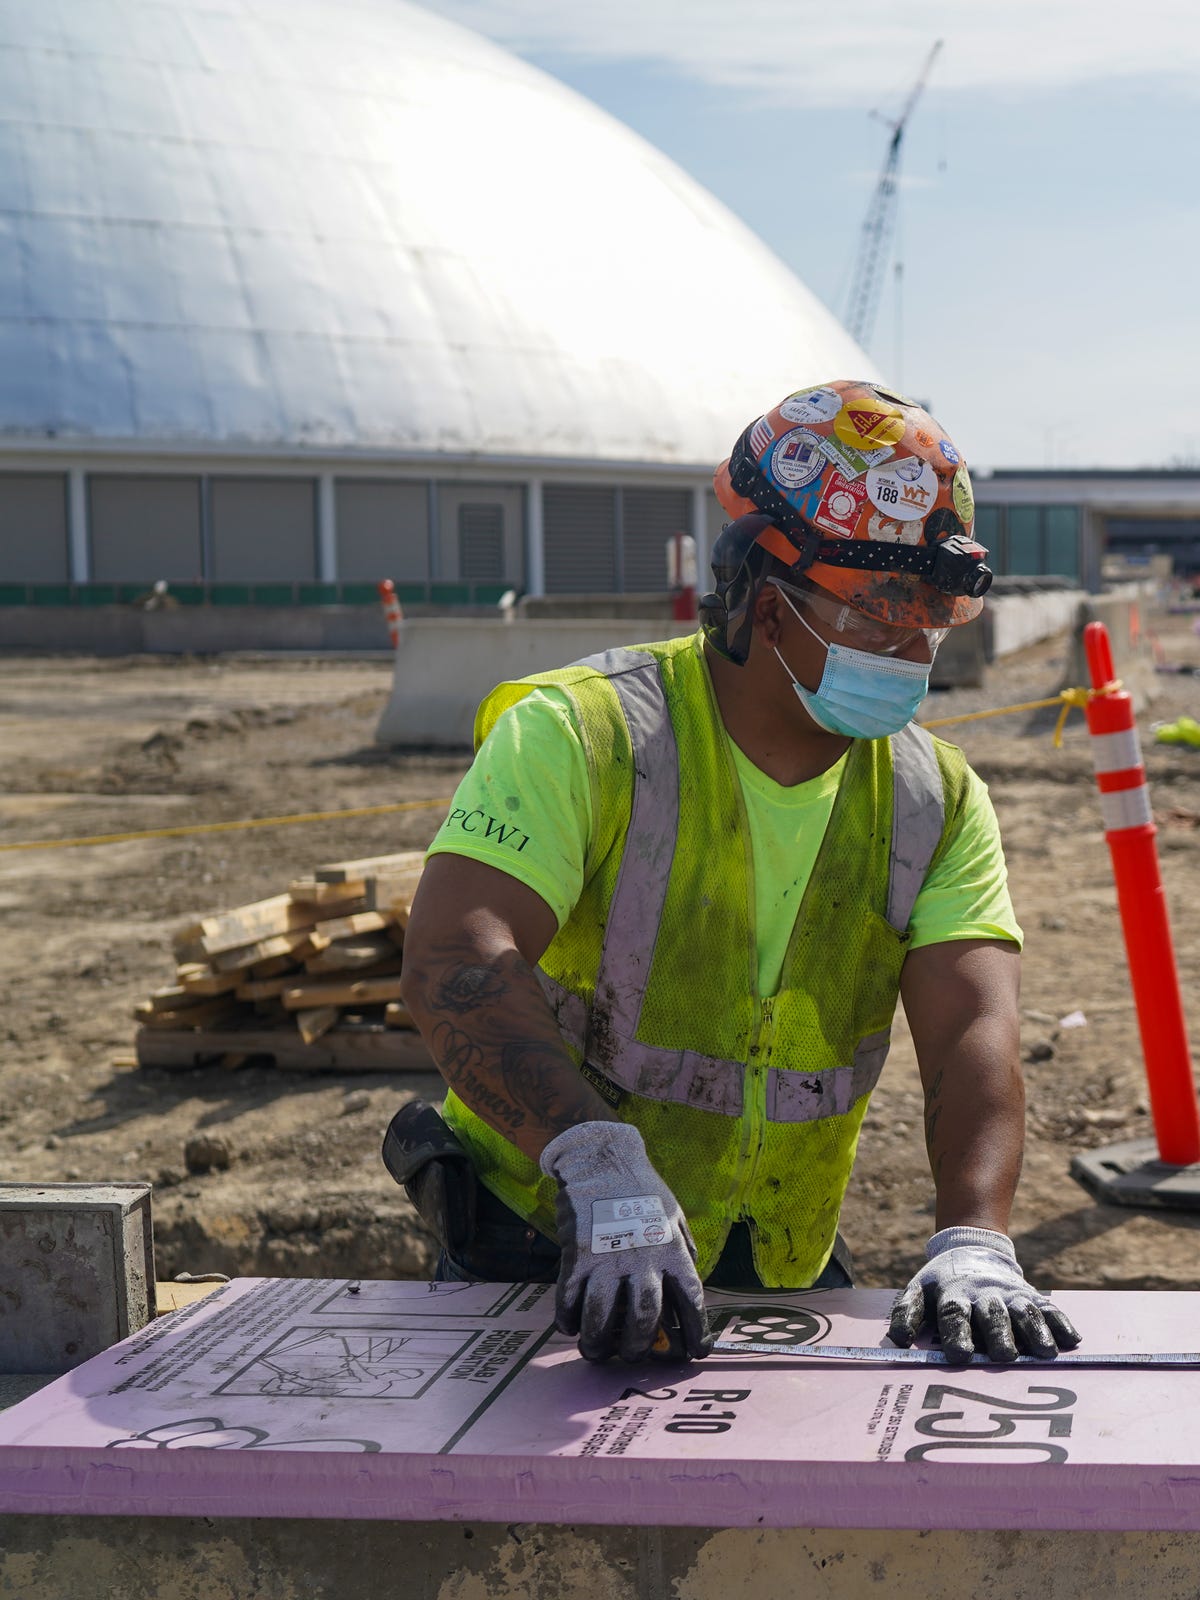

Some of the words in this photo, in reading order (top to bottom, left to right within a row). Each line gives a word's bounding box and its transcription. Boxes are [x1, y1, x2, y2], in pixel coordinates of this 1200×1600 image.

[853, 413, 882, 434] Sika
[876, 486, 899, 504] 188
[494, 1330, 535, 1355] UNDER
[447, 1330, 511, 1380] FOUNDATION
[474, 1357, 508, 1377] SLAB
[618, 1387, 678, 1401] 2
[630, 1406, 659, 1421] inch
[664, 1389, 752, 1434] R-10
[597, 1423, 622, 1433] de
[904, 1384, 1078, 1464] 250
[605, 1421, 648, 1455] thickness
